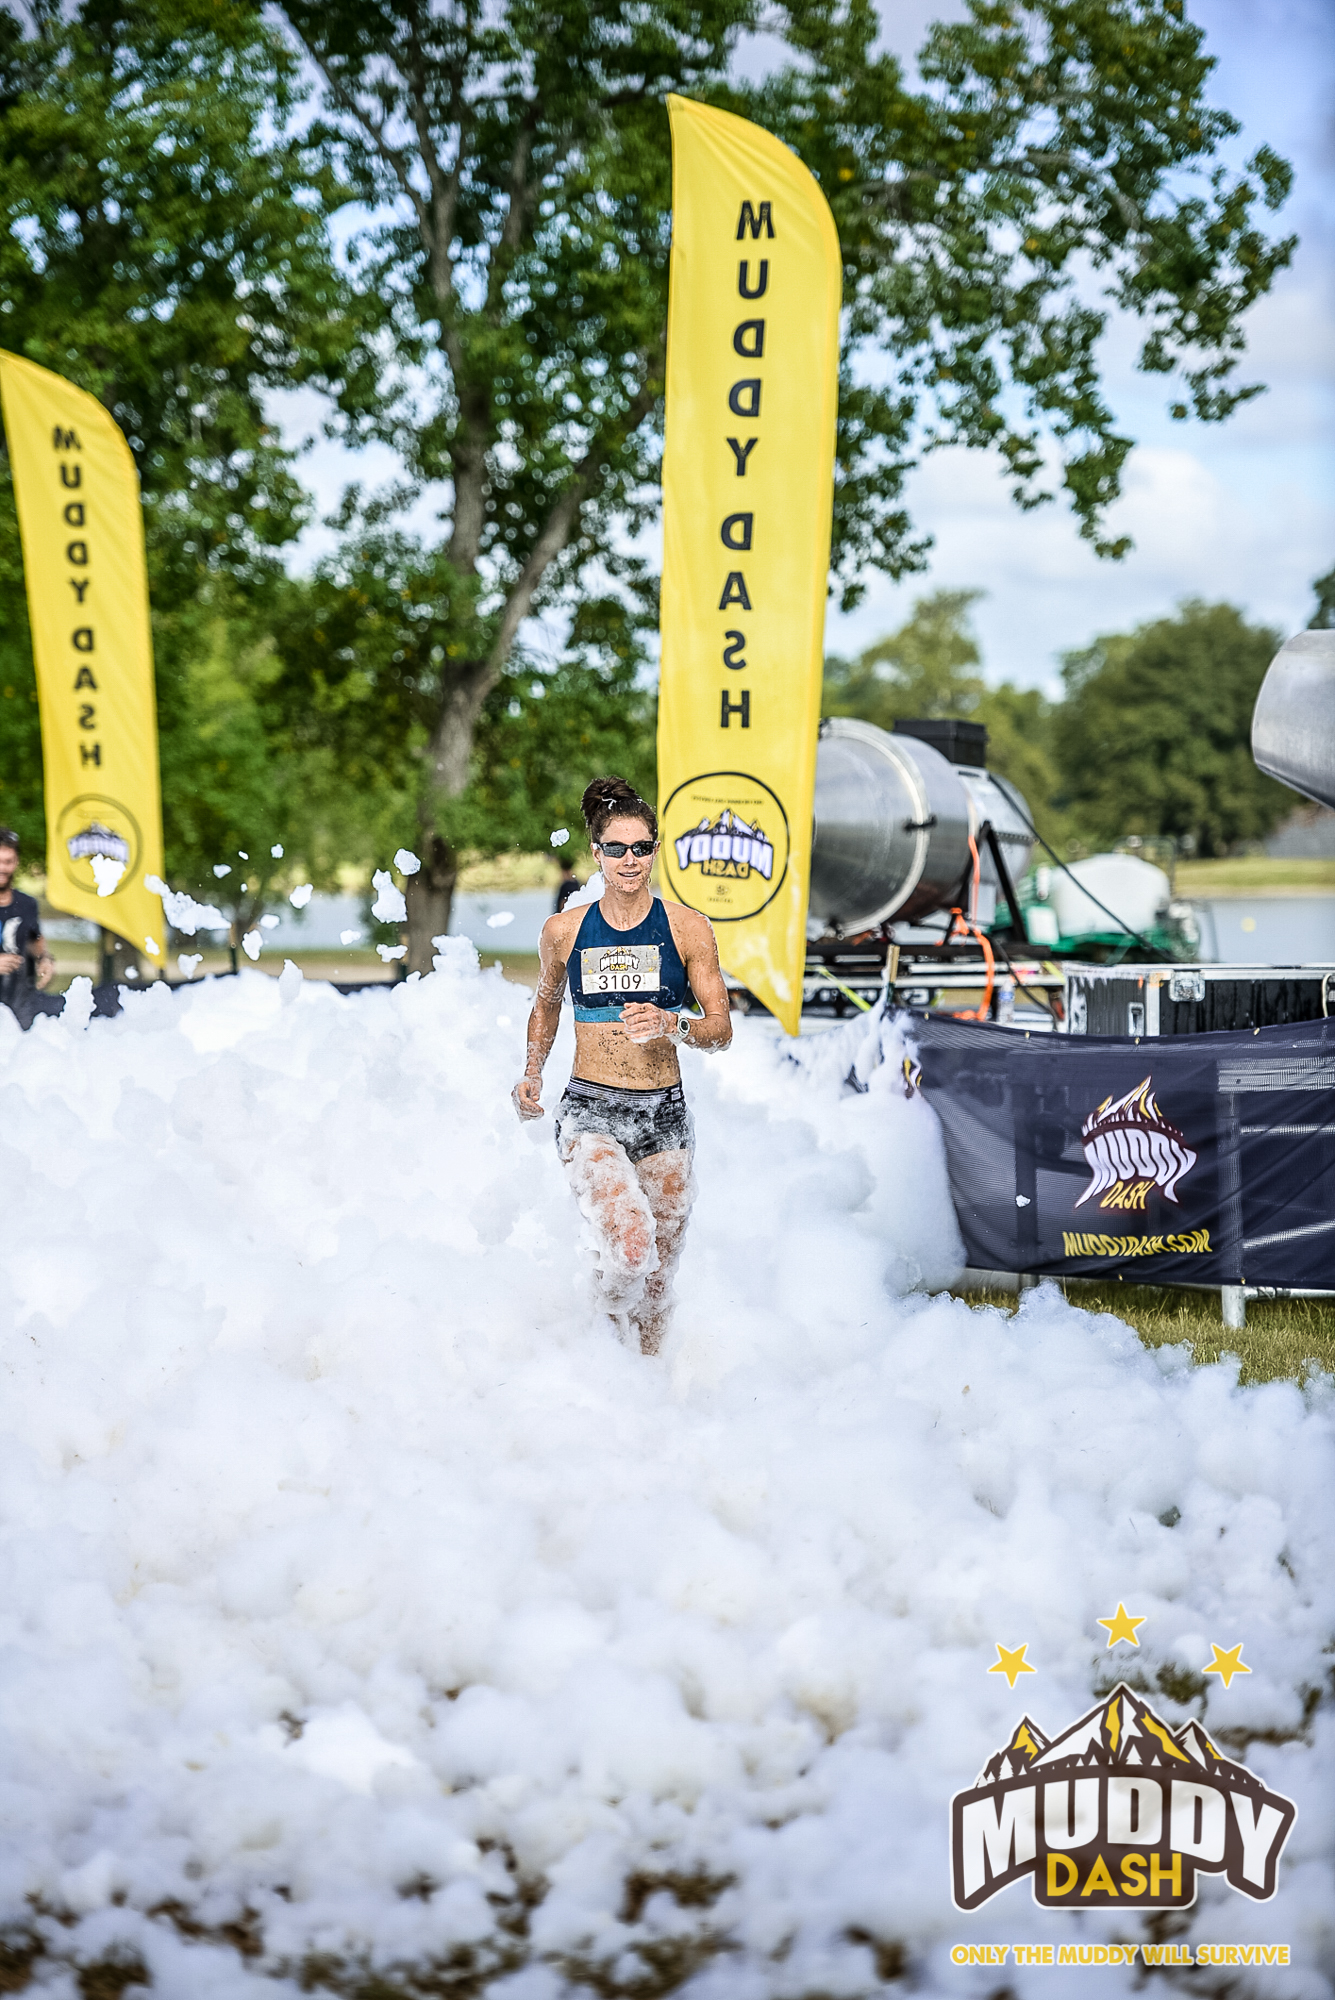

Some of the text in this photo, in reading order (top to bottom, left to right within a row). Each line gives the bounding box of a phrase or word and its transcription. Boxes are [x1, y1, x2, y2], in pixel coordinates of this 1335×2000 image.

[600, 955, 640, 972] MUDDY
[598, 974, 642, 990] 3109
[1075, 1127, 1197, 1209] MUDDY
[1100, 1181, 1156, 1210] DASH
[1062, 1229, 1213, 1258] MUDDYDASH.COM
